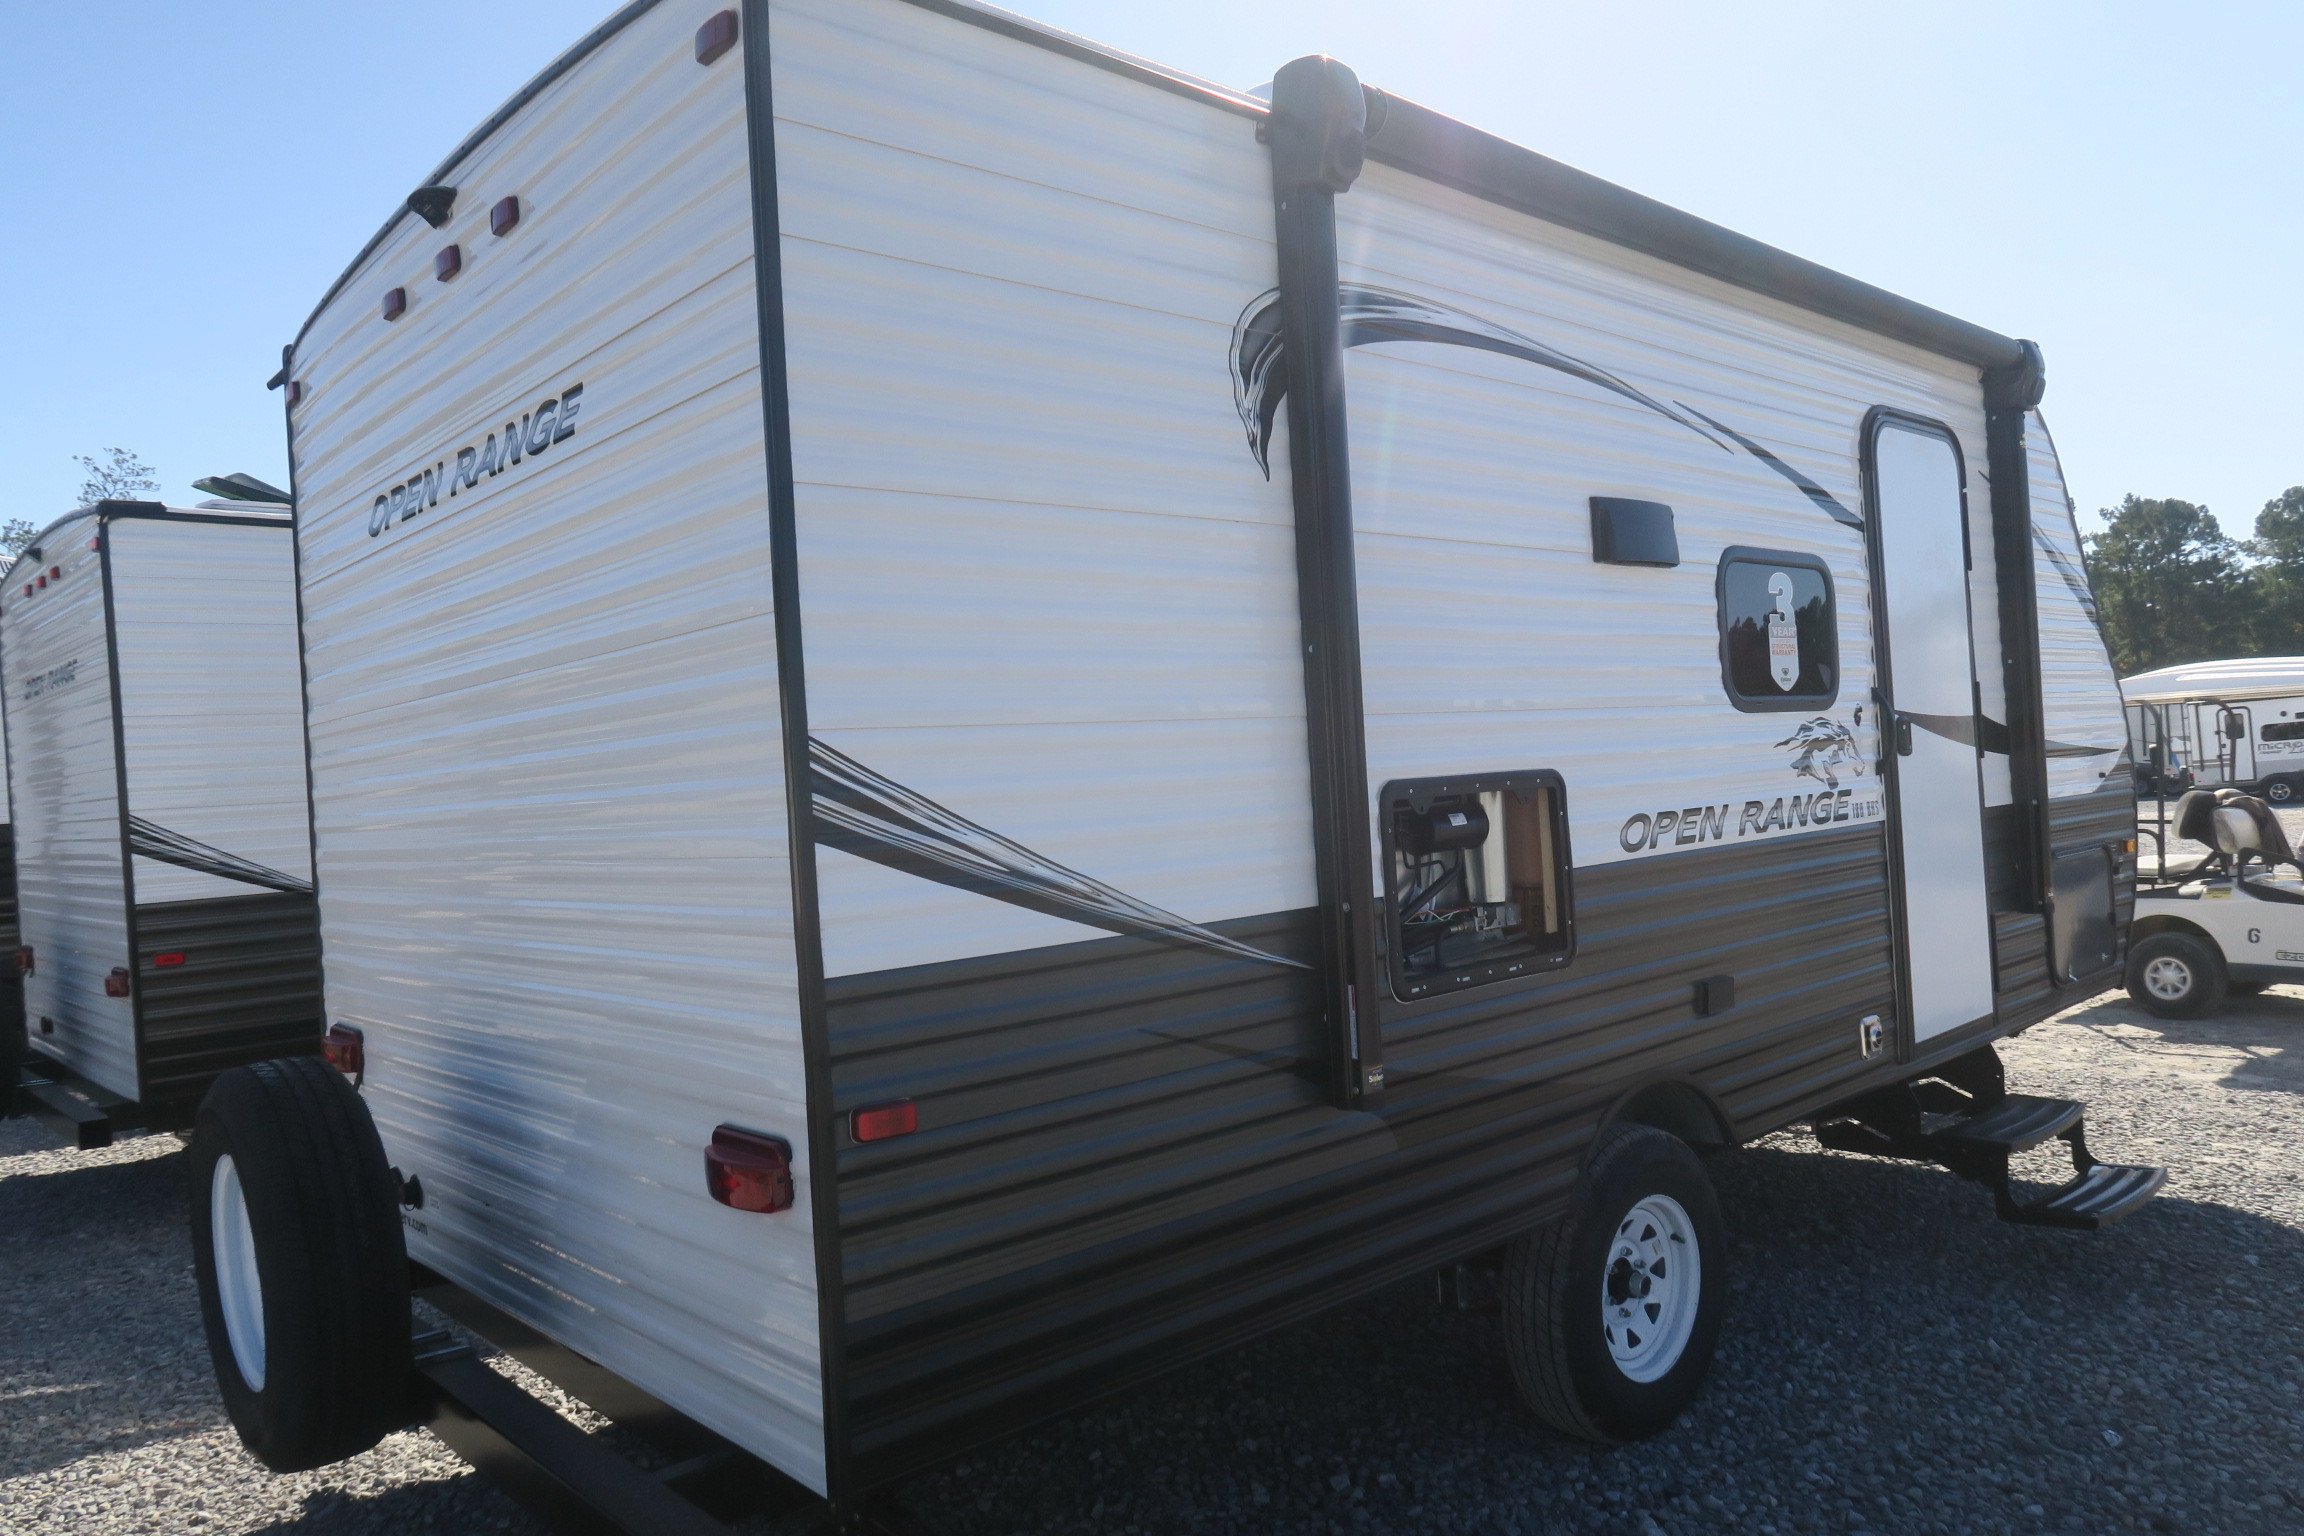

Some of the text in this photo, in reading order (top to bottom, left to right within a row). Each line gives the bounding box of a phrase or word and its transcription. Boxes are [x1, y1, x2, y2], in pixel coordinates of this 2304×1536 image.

[368, 382, 583, 538] OPEN RANGE
[1620, 804, 1729, 853] OPEN
[1739, 789, 1852, 836] RANGE
[2248, 928, 2260, 943] 6
